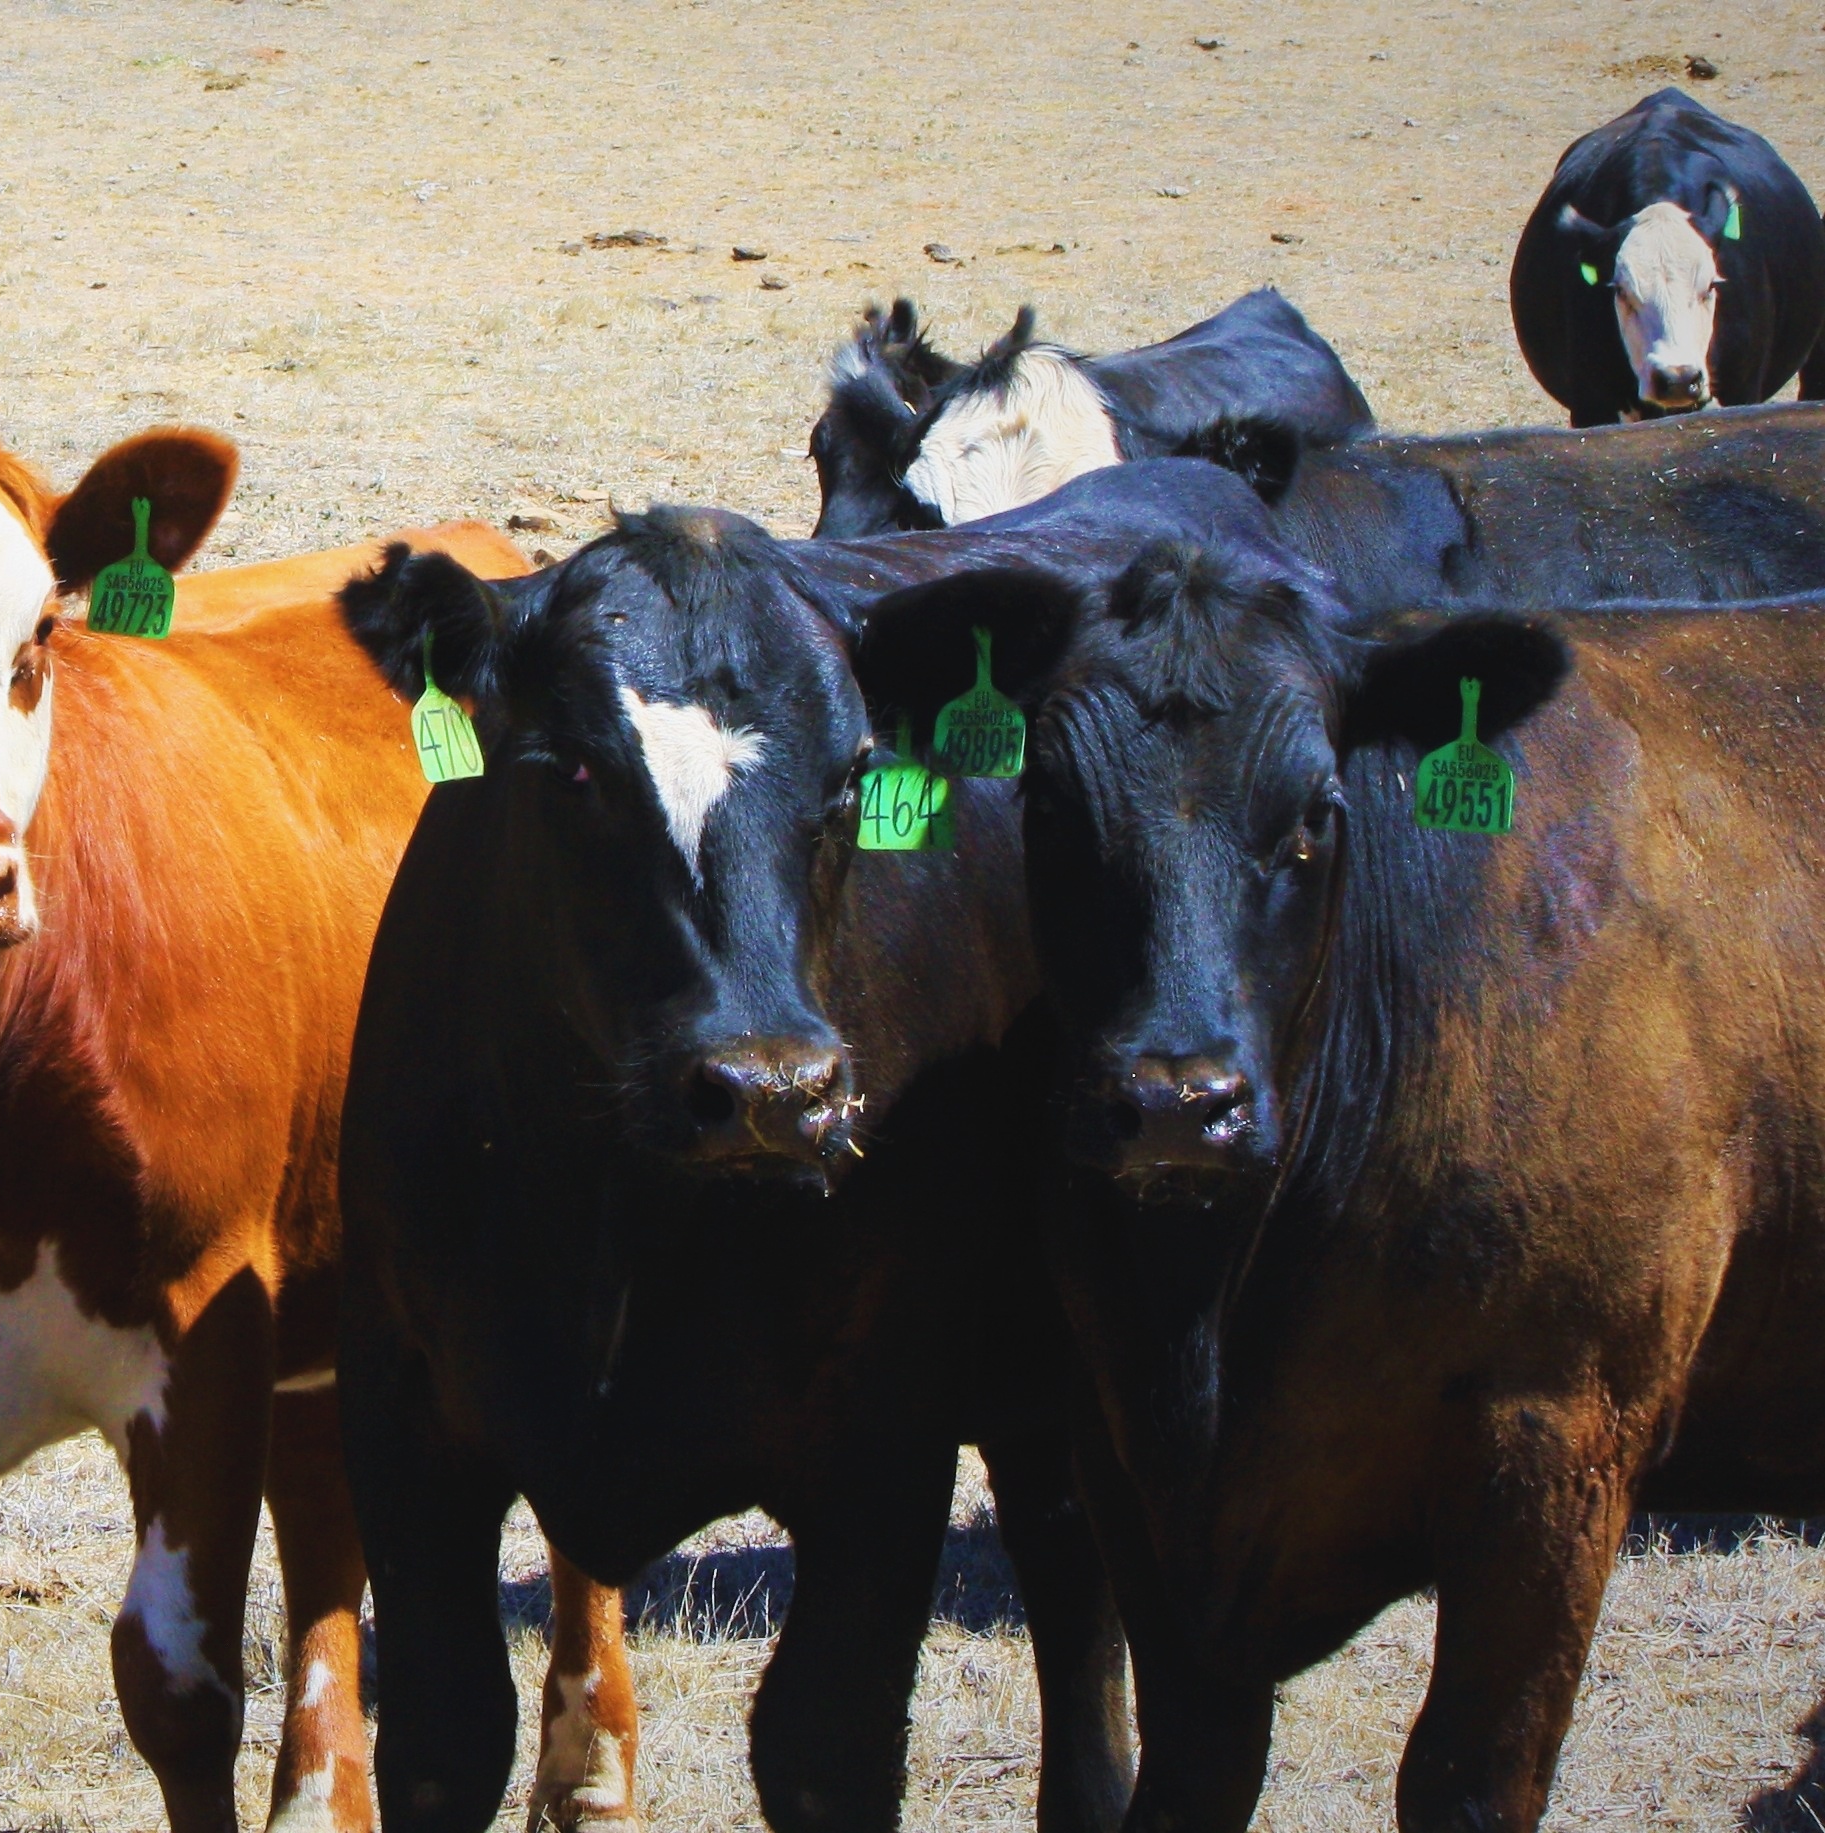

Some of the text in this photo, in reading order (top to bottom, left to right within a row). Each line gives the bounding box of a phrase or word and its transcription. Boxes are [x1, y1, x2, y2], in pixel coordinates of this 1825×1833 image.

[93, 590, 169, 636] 49723
[420, 705, 479, 780] 470
[1431, 759, 1500, 780] SA556025
[862, 773, 942, 845] 464
[1422, 778, 1507, 830] 49551
